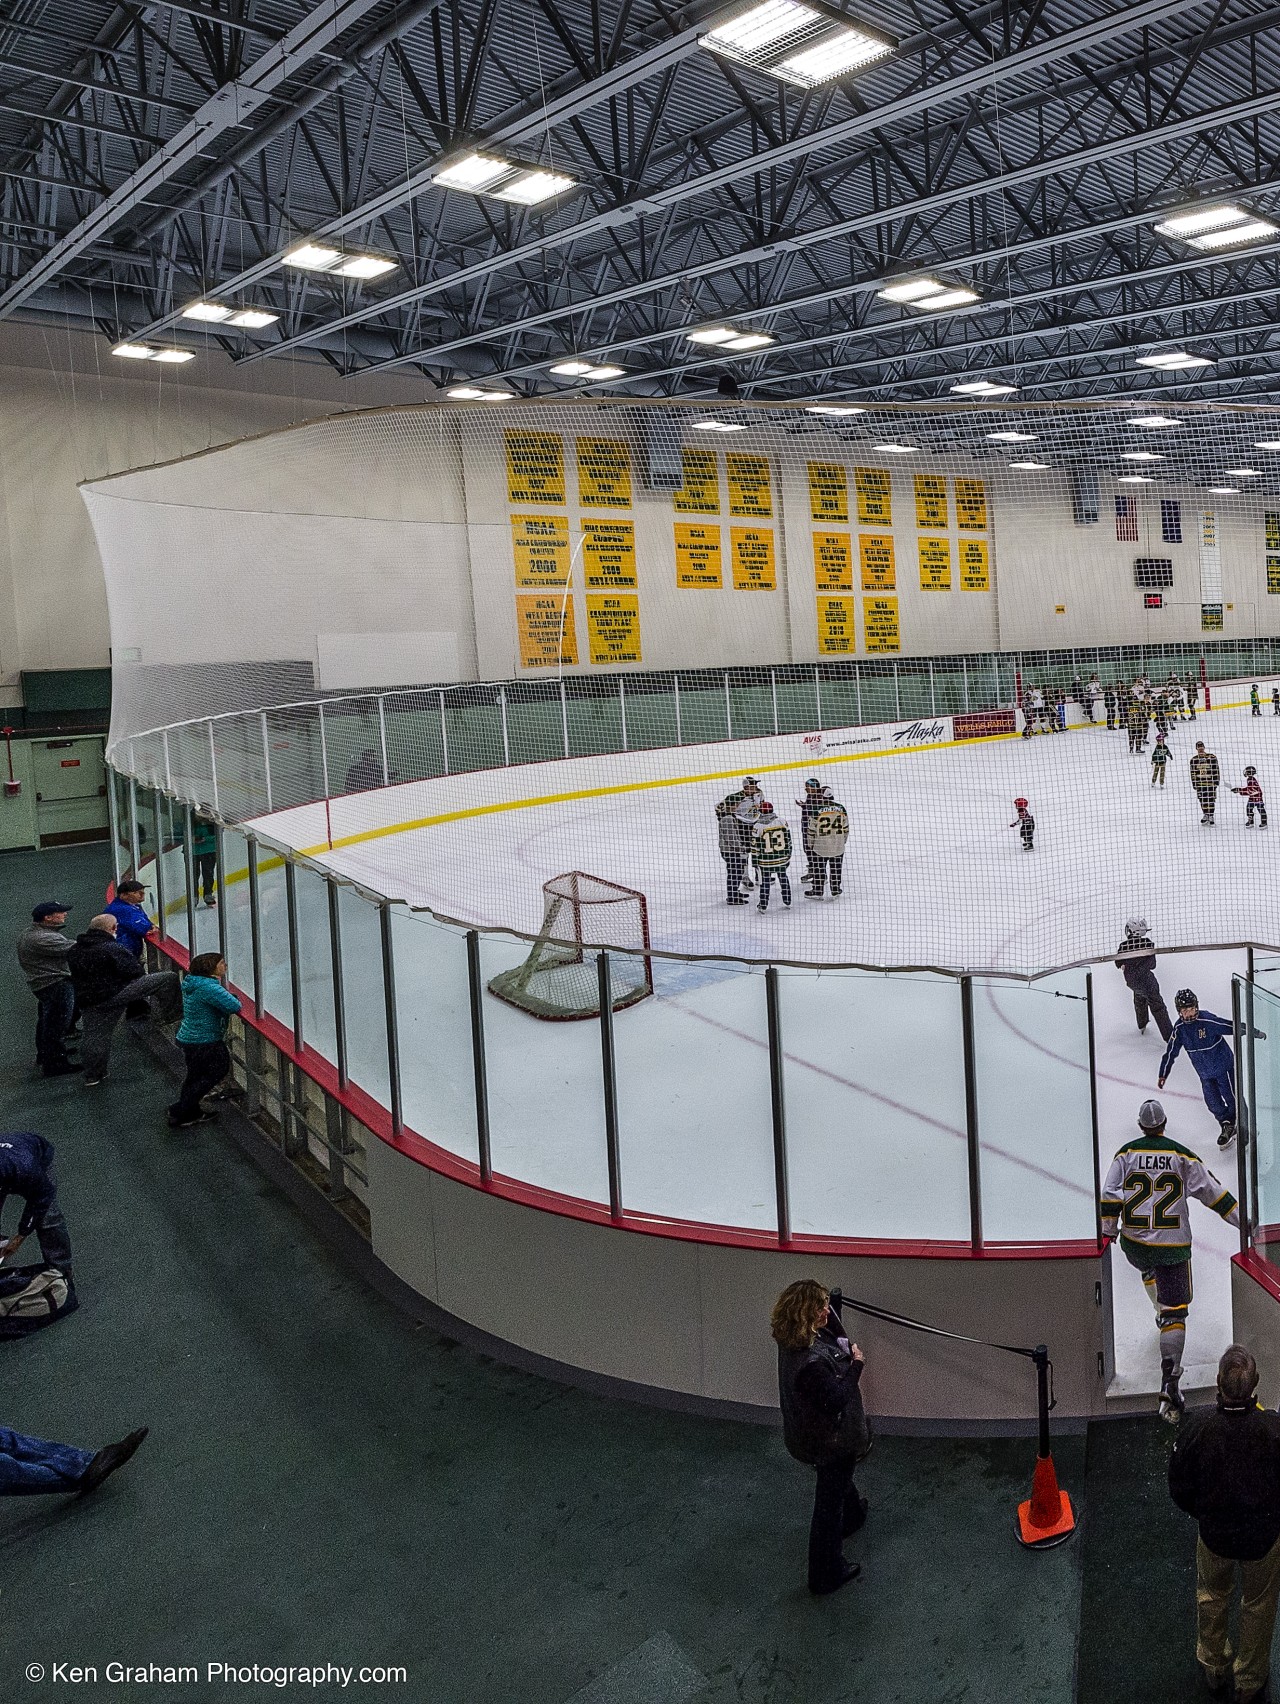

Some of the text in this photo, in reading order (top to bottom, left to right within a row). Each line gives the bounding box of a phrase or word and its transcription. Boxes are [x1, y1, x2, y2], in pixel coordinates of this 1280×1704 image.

[803, 735, 822, 744] AVIS
[892, 721, 945, 741] Alaska
[818, 815, 843, 837] 24
[762, 830, 786, 853] 13
[1138, 1155, 1173, 1171] LEASK
[1122, 1171, 1184, 1230] 22
